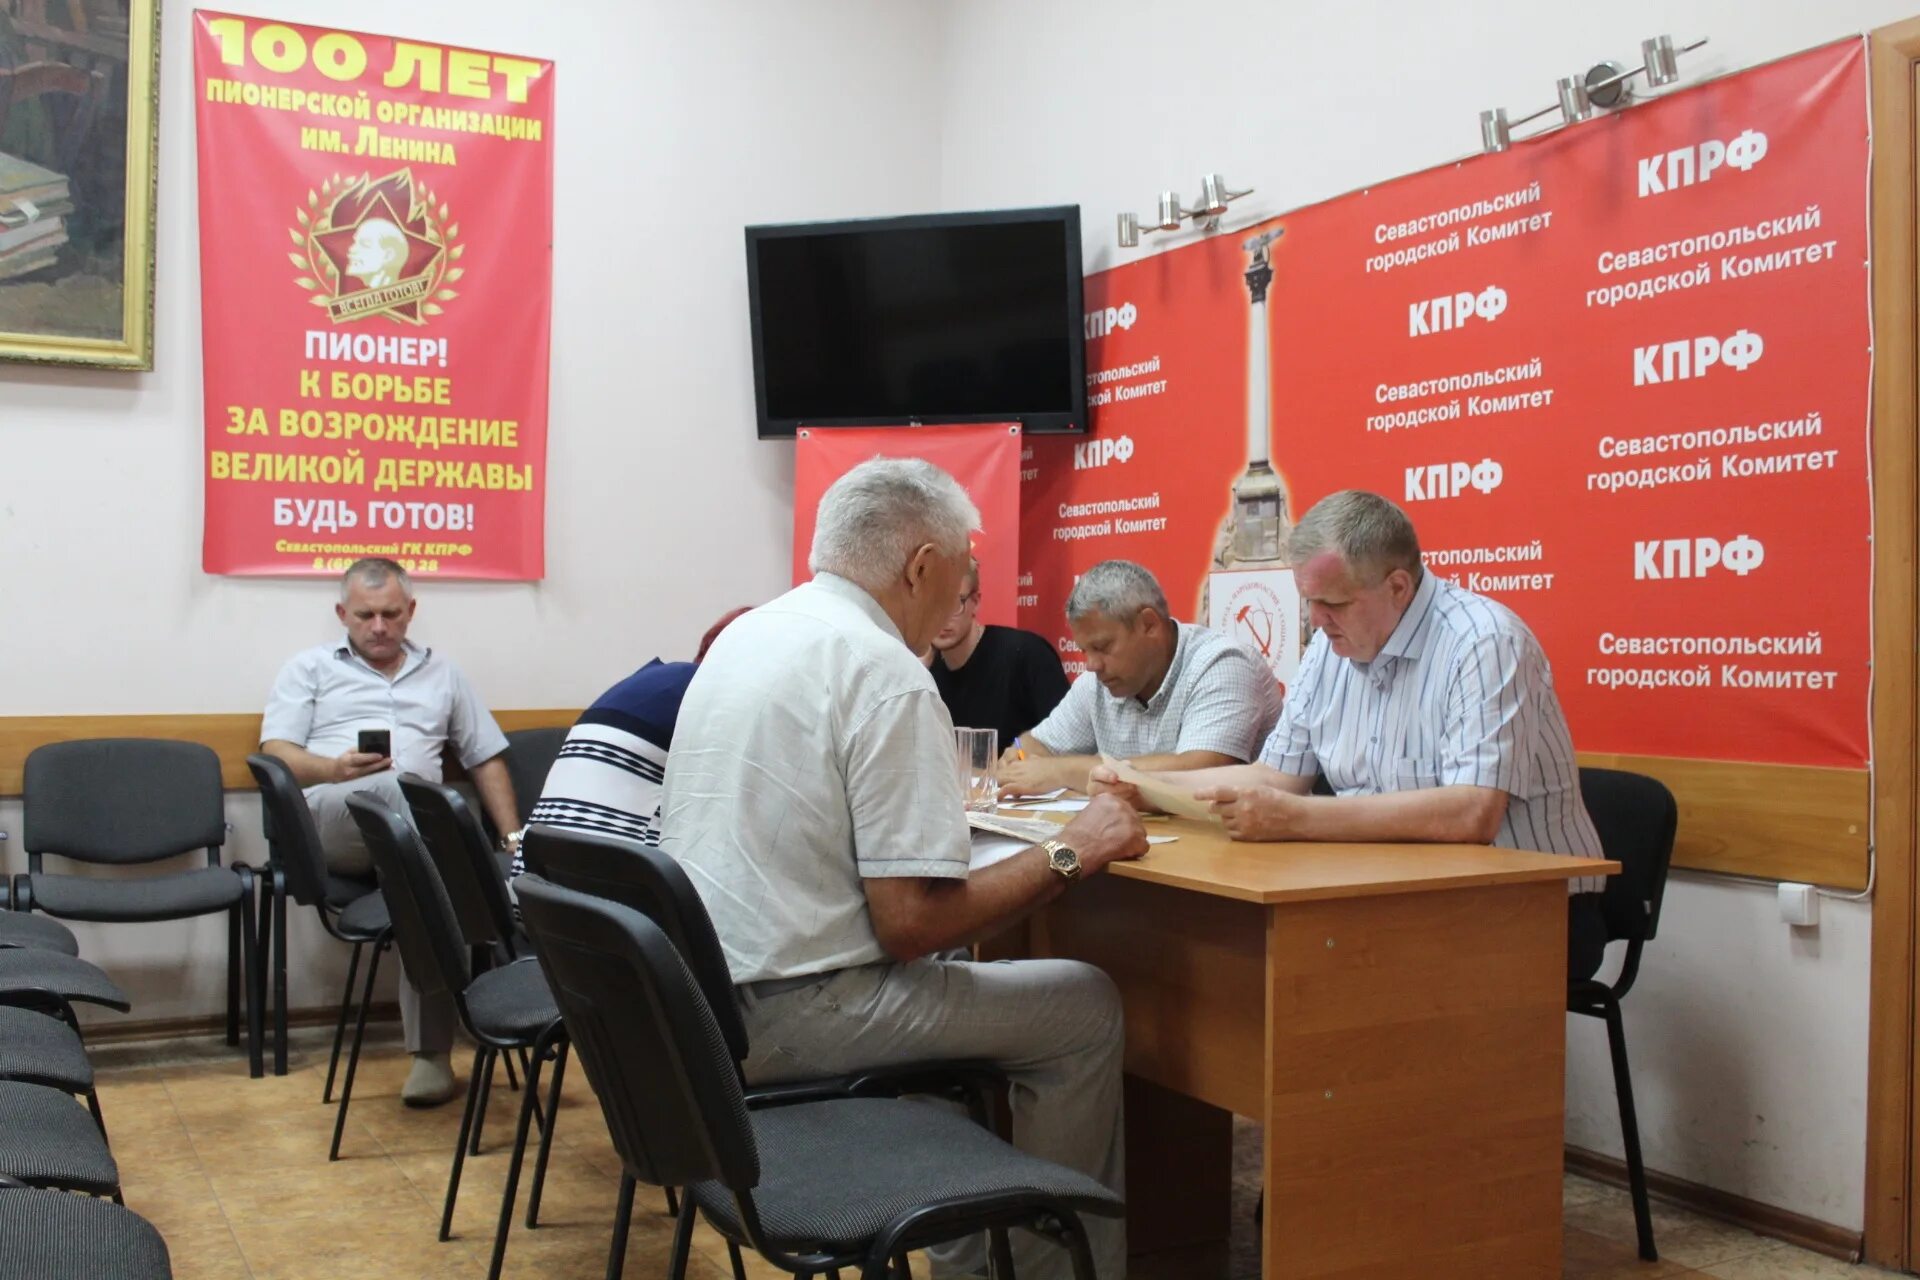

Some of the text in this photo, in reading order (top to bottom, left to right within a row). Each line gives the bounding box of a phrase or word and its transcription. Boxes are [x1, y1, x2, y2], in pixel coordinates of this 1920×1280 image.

[208, 18, 543, 104] 100 ЛЕТ
[206, 78, 543, 143] ПИОНЕРСКОЙ ОРГАНИЗАЦИИ
[1637, 129, 1768, 198] КПРФ
[1374, 181, 1541, 246] Севастопольский
[1365, 209, 1553, 273] городской Комитет
[1597, 204, 1821, 275] Севастопольский
[1586, 238, 1838, 308] городской Комитет
[1408, 285, 1508, 338] КПРФ
[305, 330, 448, 368] ПИОНЕР!
[1633, 329, 1764, 387] КПРФ
[300, 369, 451, 405] К БОРЬБЕ
[1086, 355, 1160, 388] стопольский
[1115, 380, 1167, 402] Комитет
[1375, 358, 1542, 405] Севастопольский
[226, 406, 519, 449] ЗА ВОЗРОЖДЕНИЕ
[1366, 387, 1554, 433] городской Комитет
[1073, 435, 1134, 470] КПРФ
[1598, 412, 1822, 459] Севастопольский
[210, 448, 533, 491] ВЕЛИКОЙ ДЕРЖАВЫ
[1405, 458, 1503, 501] КПРФ
[1587, 447, 1839, 493] городской Комитет
[274, 497, 474, 533] БУДЬ ГОТОВ!
[1058, 492, 1160, 519] Севастопольский
[401, 542, 422, 556] ГК
[425, 543, 473, 556] КПРФ
[1053, 516, 1167, 541] городской Комитет
[1420, 540, 1542, 565] стопольский
[1634, 535, 1766, 581] КПРФ
[1468, 572, 1554, 591] Комитет
[1598, 631, 1822, 656] Севастопольский
[1587, 663, 1838, 691] городской Комитет
